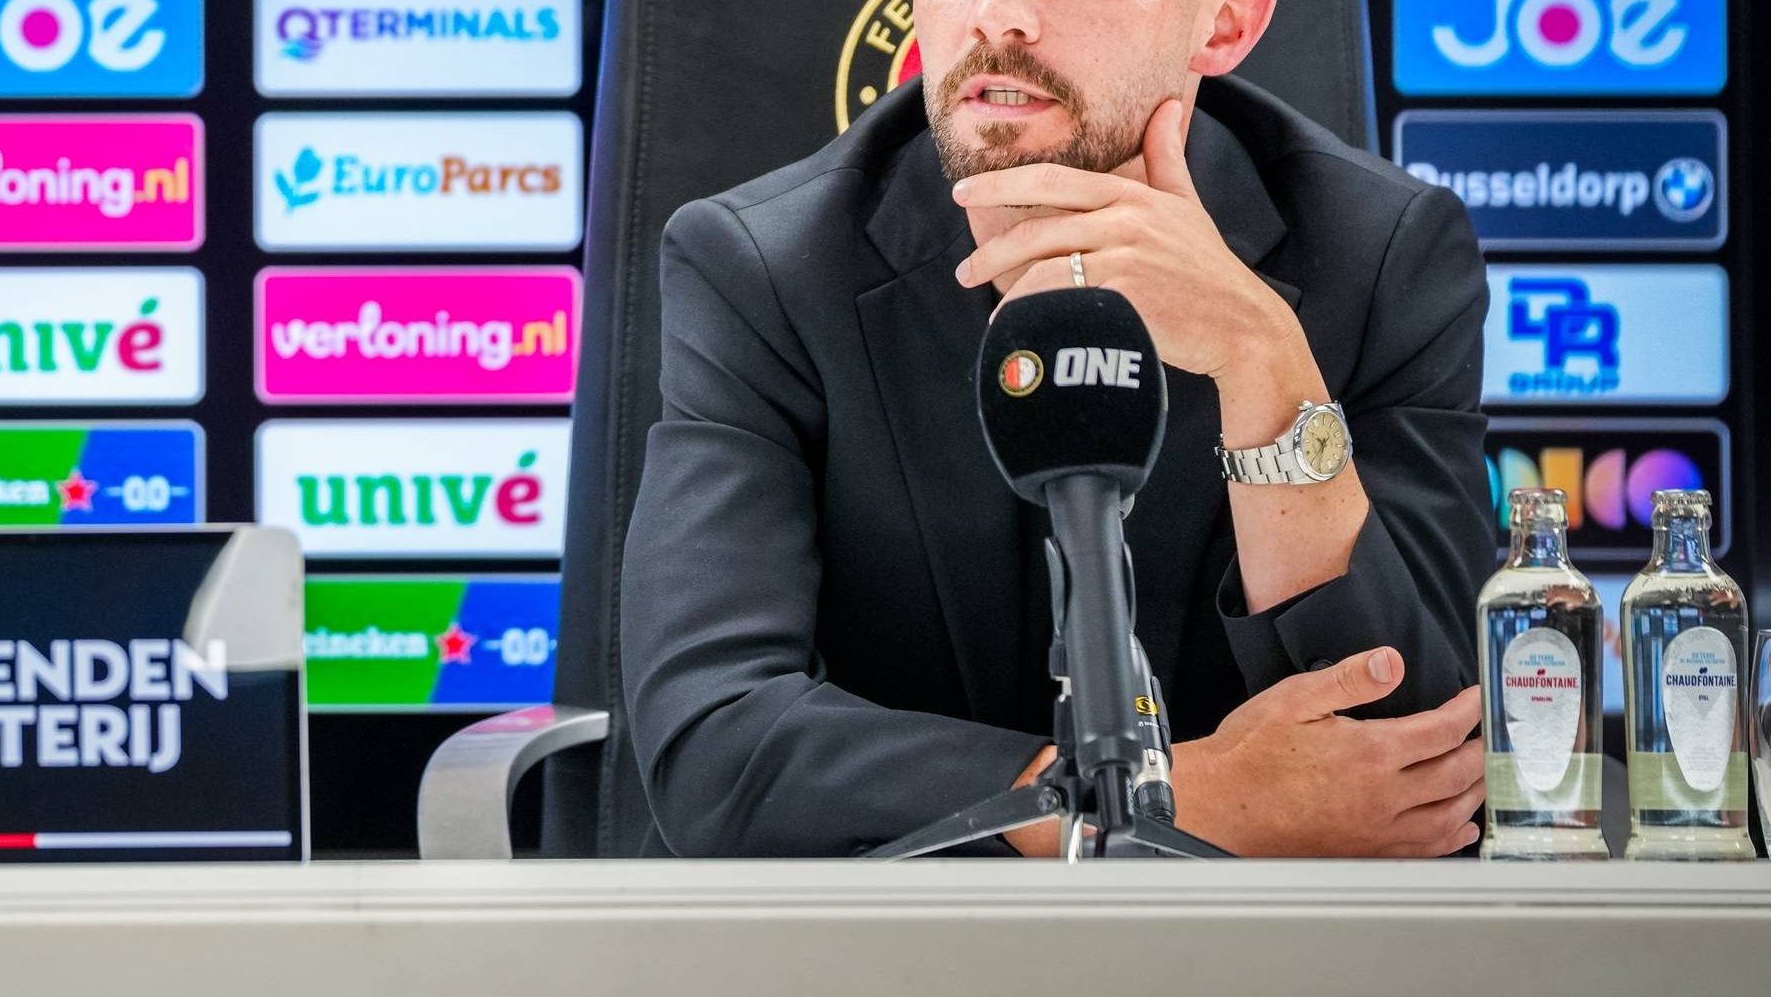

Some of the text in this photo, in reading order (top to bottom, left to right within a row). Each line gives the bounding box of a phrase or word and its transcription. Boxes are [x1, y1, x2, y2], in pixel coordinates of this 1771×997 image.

[276, 6, 559, 61] QTERMINALS
[332, 156, 561, 195] EuroParcs
[271, 300, 567, 371] verloning.nl
[1053, 347, 1142, 389] ONE
[297, 450, 542, 526] univé
[1505, 676, 1577, 689] CHAUDFONTAINE
[1666, 674, 1736, 687] CHAUDFONTAINE
